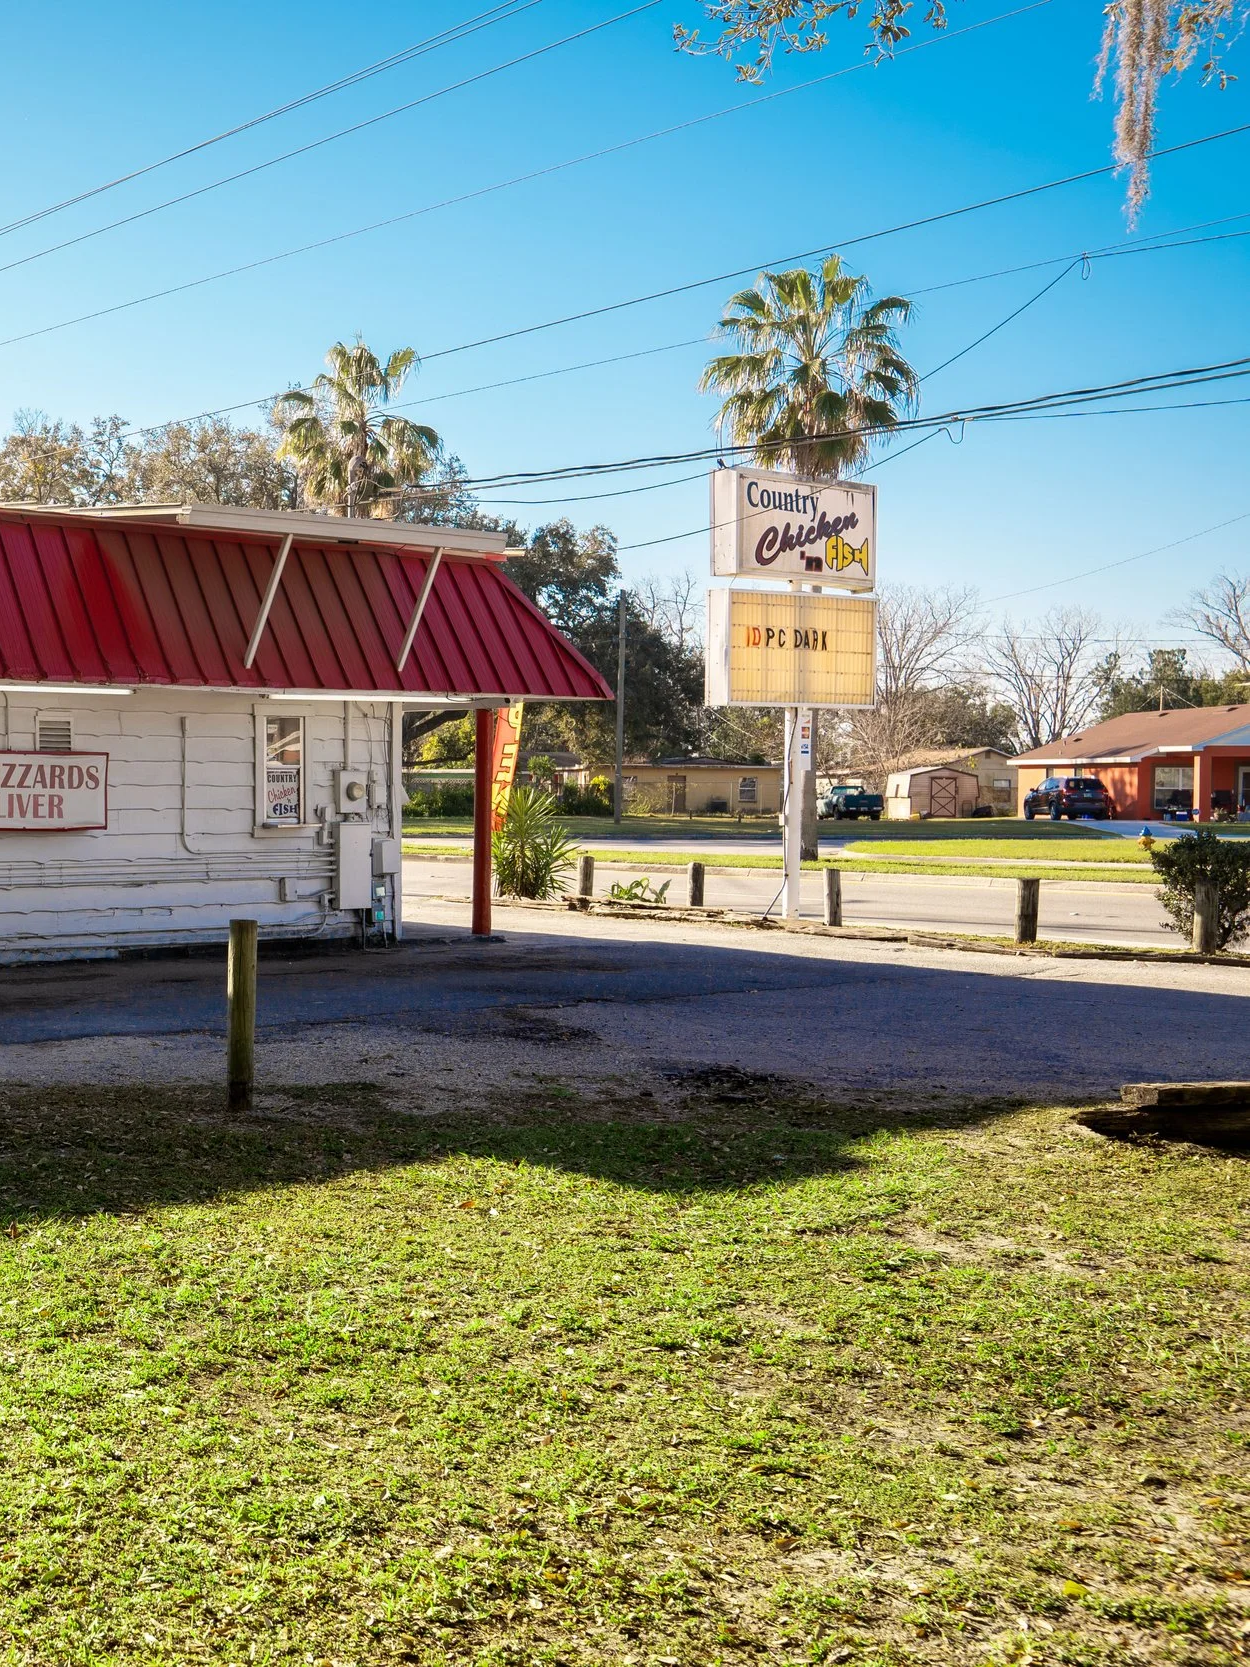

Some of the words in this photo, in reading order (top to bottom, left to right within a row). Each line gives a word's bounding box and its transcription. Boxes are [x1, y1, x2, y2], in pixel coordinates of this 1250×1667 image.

[747, 482, 819, 522] Country
[755, 511, 859, 566] Chicken
[794, 629, 827, 652] DARK
[267, 774, 297, 783] COUNTRY
[267, 785, 296, 803] Chicken
[272, 803, 298, 815] FISH
